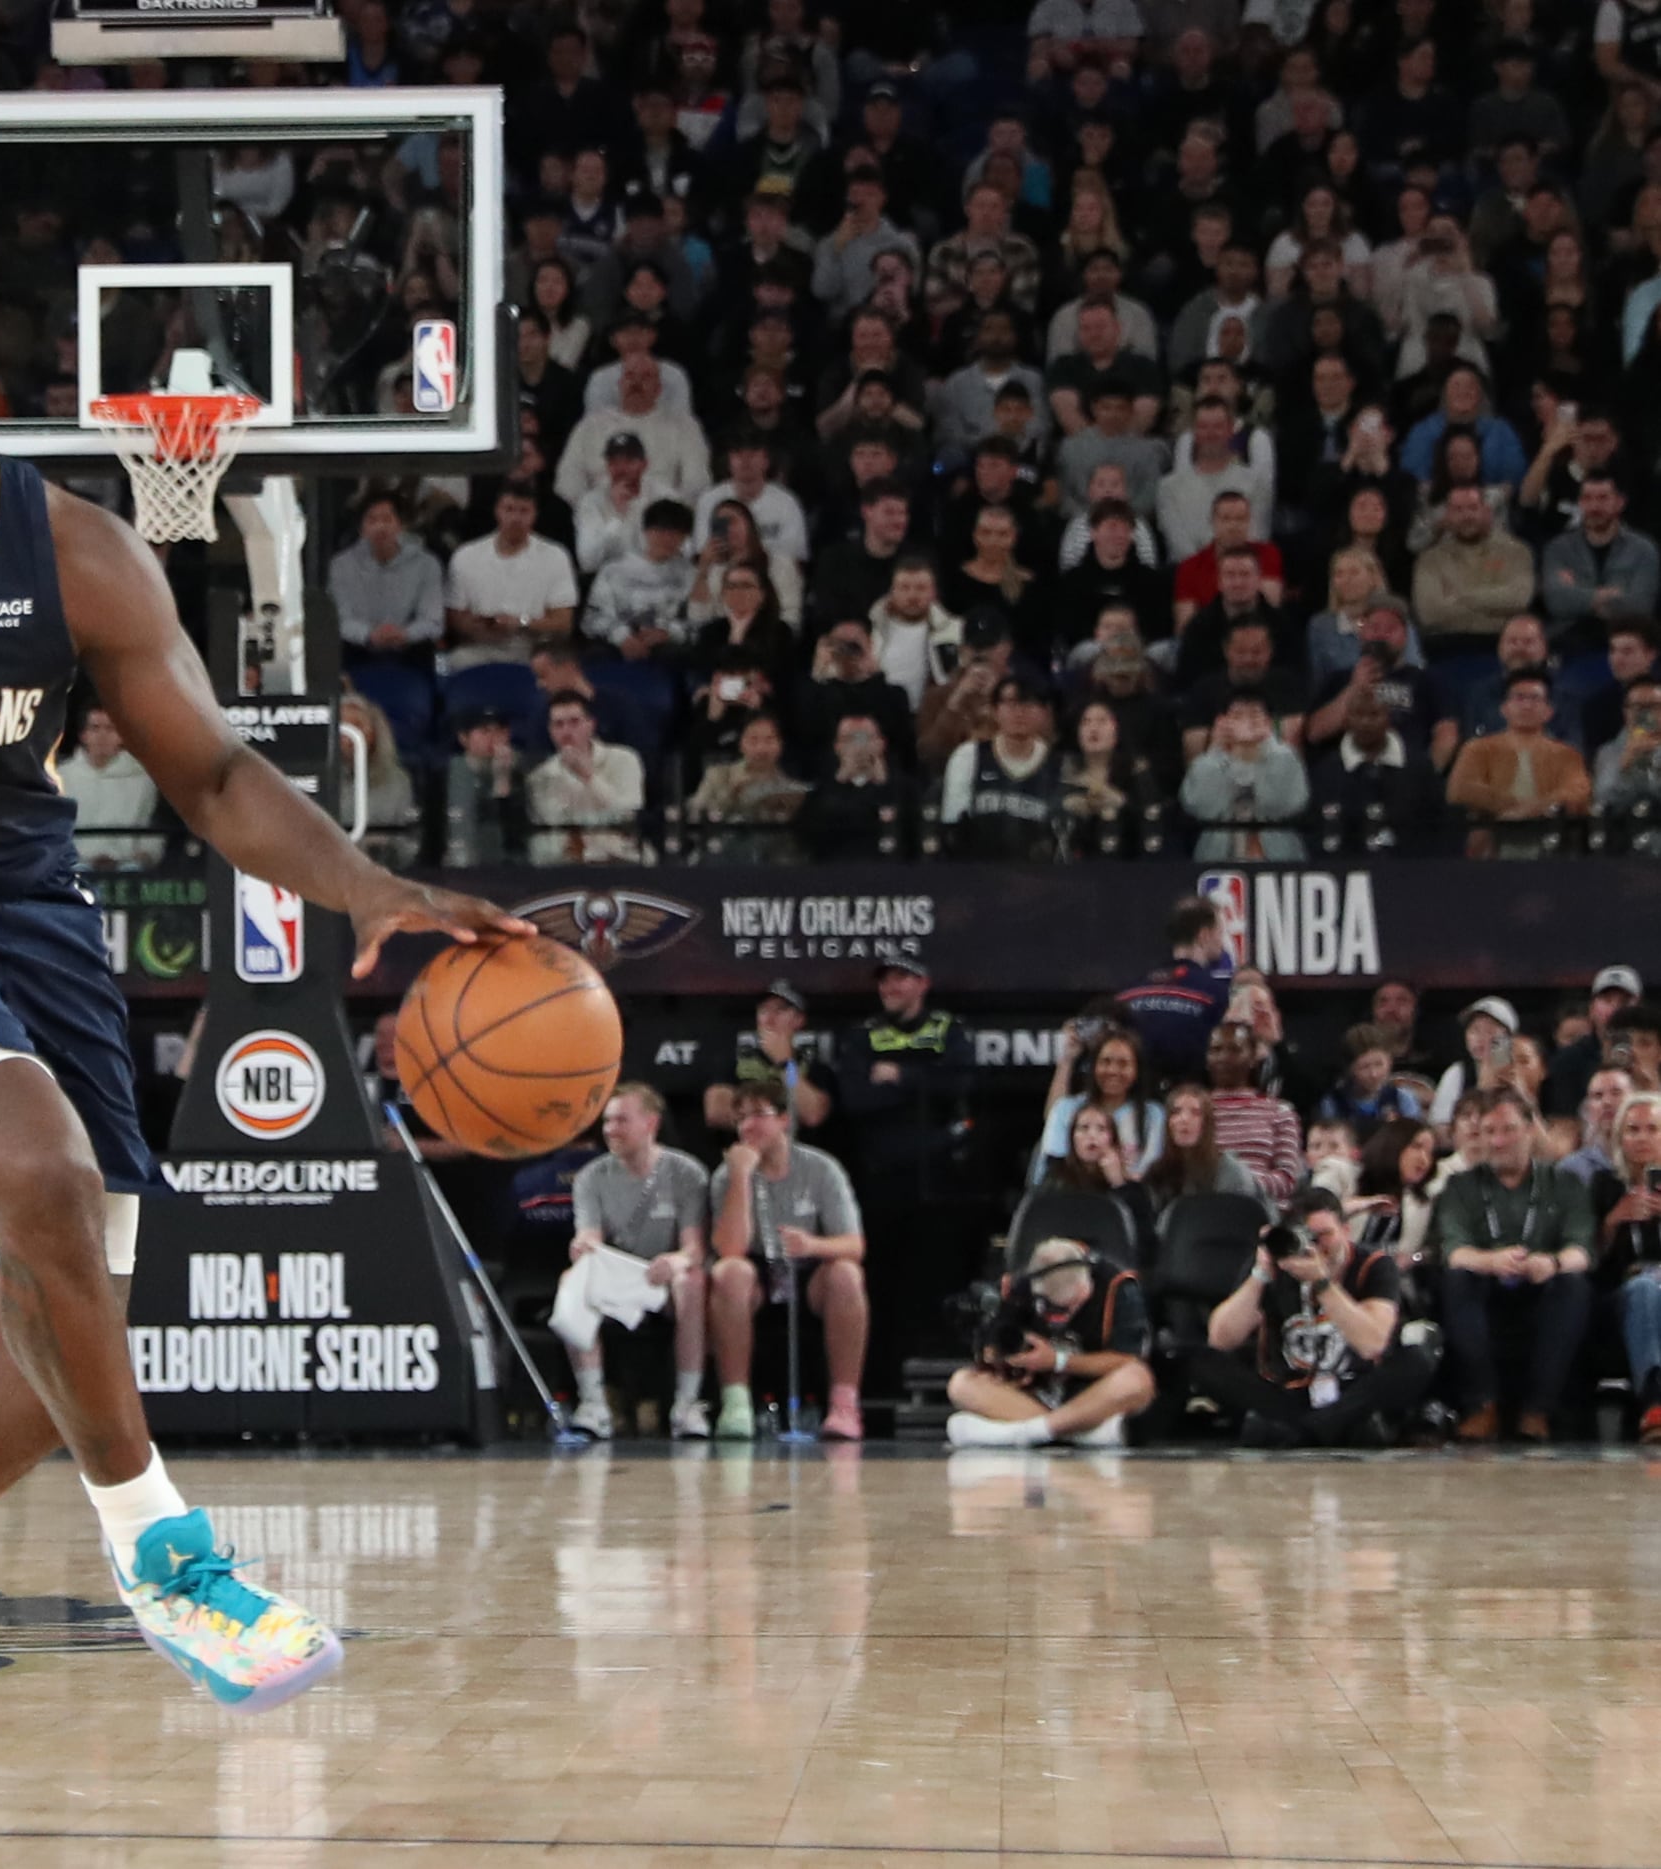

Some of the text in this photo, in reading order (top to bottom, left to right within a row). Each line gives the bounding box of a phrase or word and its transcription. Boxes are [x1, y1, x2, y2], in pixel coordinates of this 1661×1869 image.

[261, 705, 330, 725] LAVER
[722, 896, 935, 936] NEW ORLEANS
[1254, 872, 1381, 975] NBA
[734, 938, 921, 958] PELICANS
[655, 1041, 697, 1065] AT
[243, 1066, 297, 1102] NBL
[161, 1160, 379, 1193] MELBOURNE
[188, 1252, 351, 1319] NBA NBL
[127, 1324, 439, 1393] ELBOURNE SERIES
